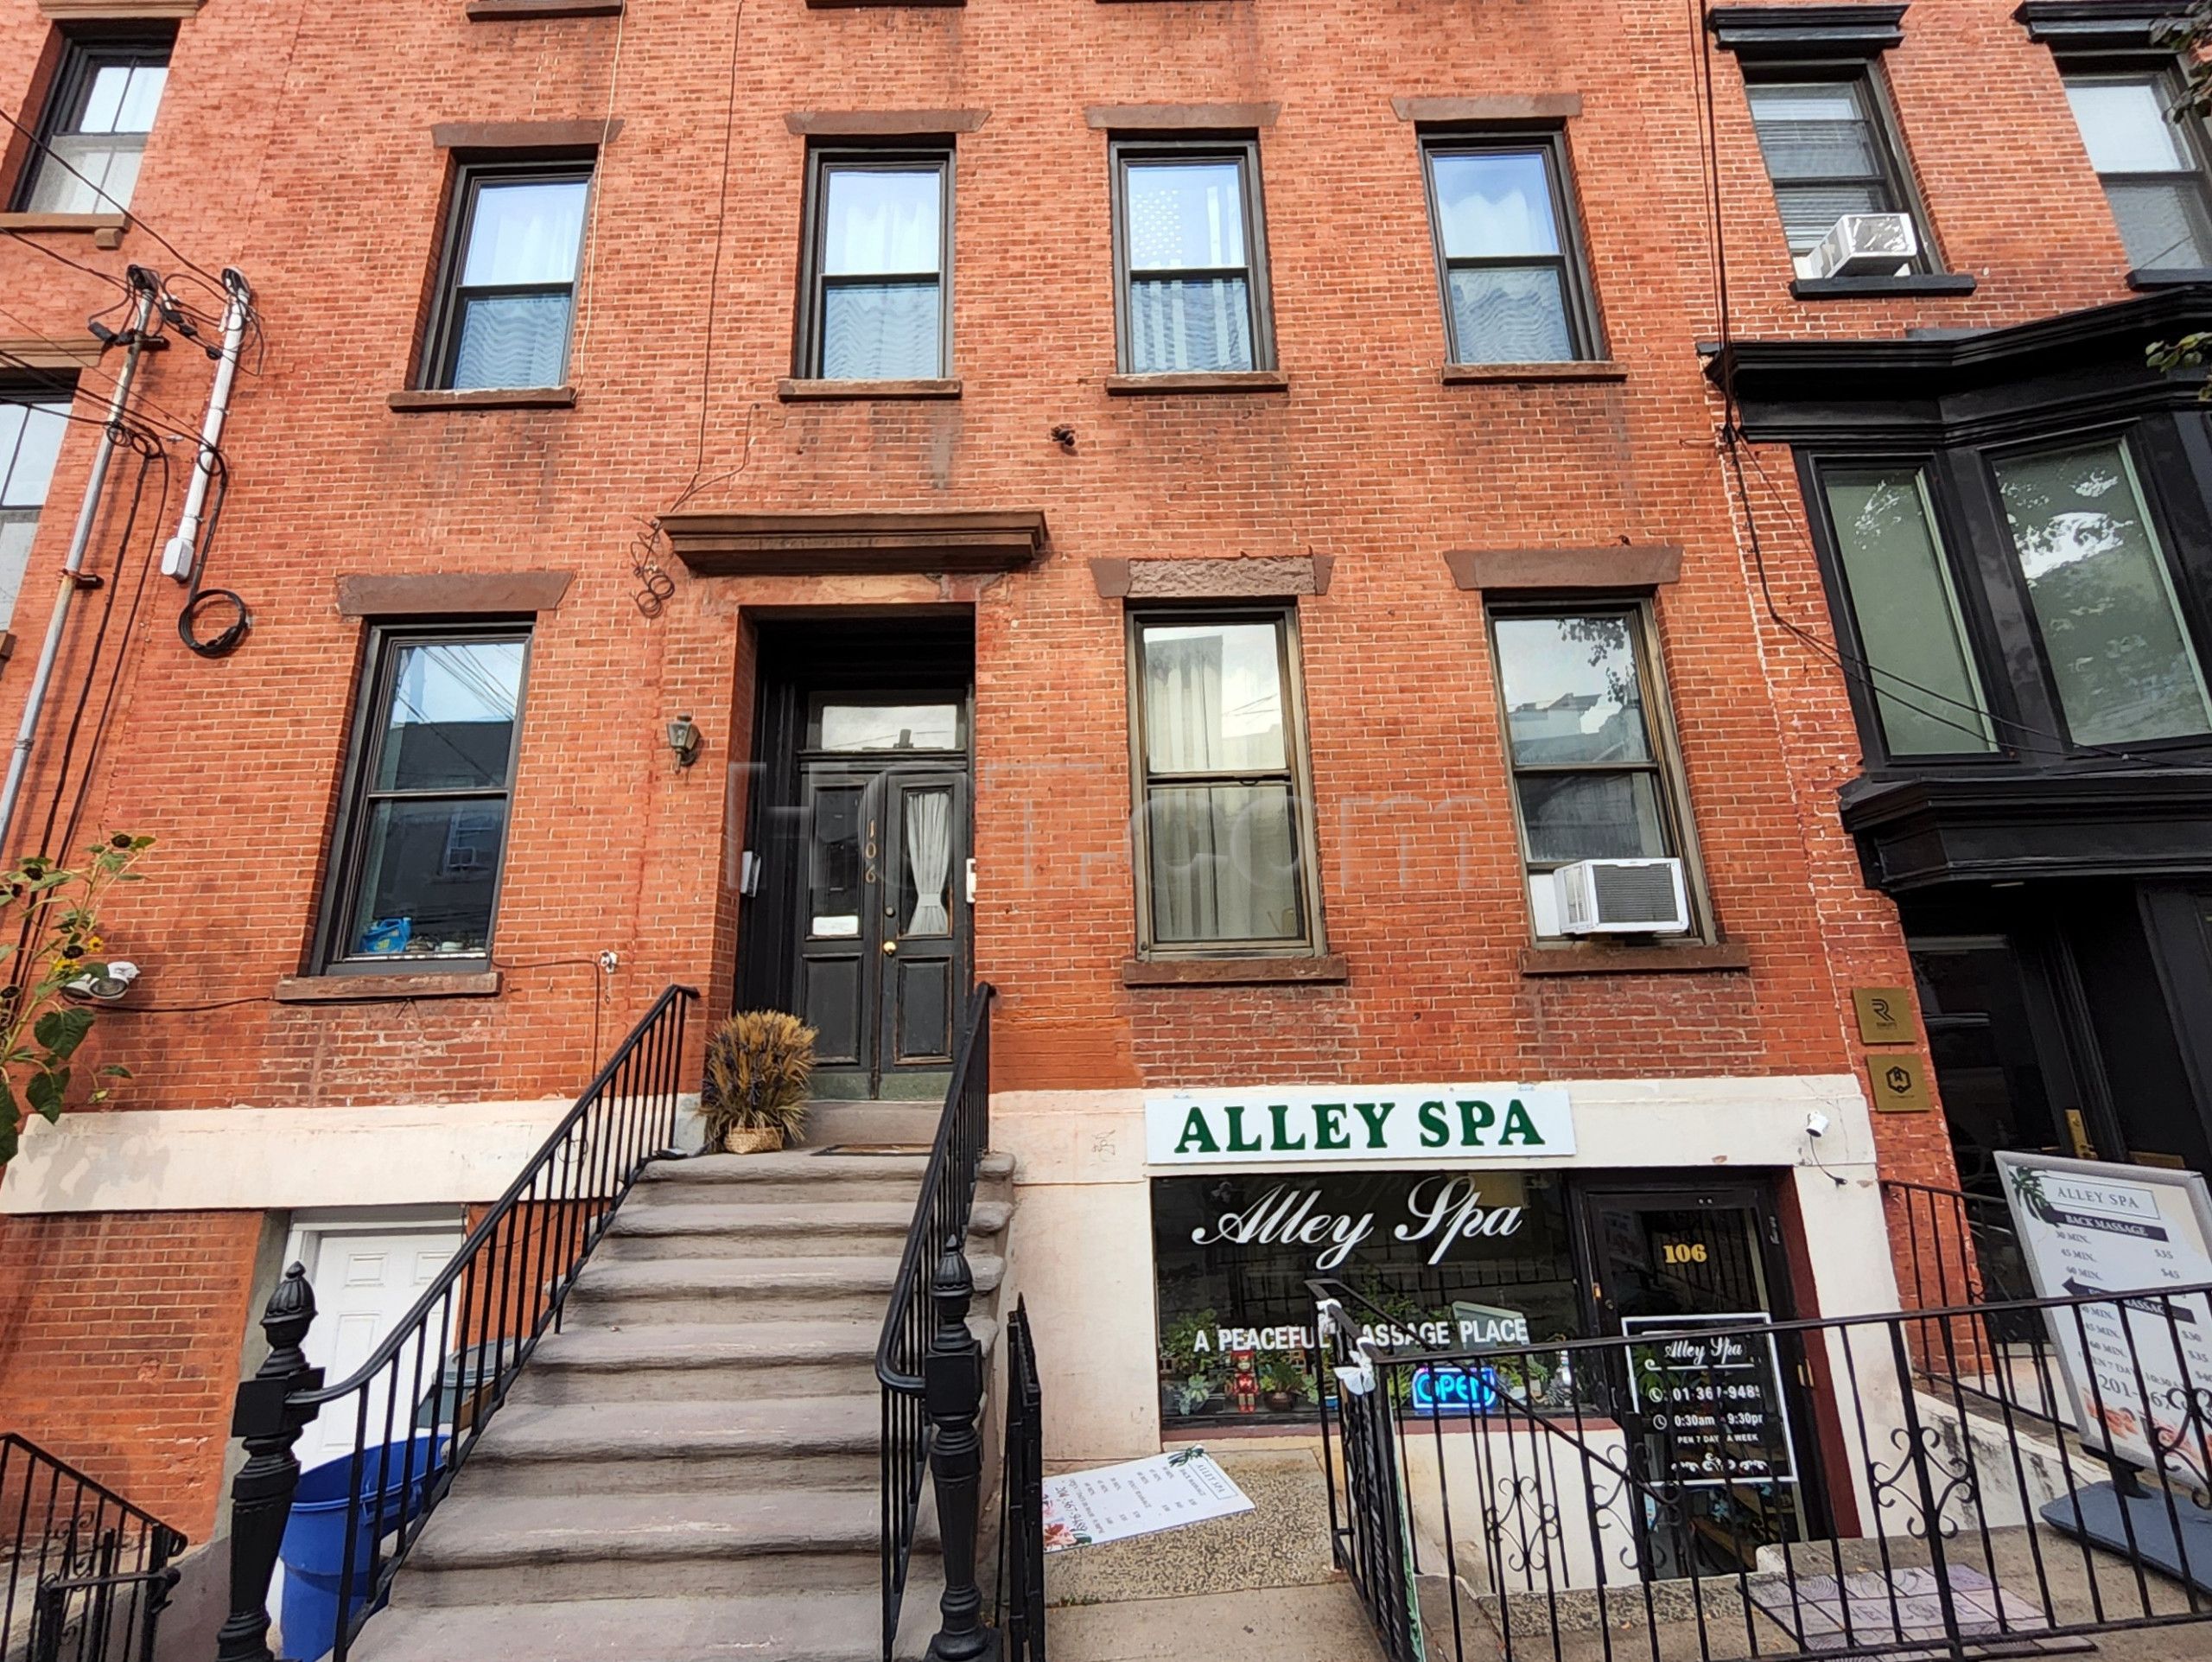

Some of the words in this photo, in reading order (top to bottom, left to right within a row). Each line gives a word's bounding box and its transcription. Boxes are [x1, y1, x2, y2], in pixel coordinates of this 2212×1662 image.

[865, 819, 877, 884] 106
[1173, 1101, 1395, 1153] ALLEY
[1417, 1098, 1546, 1148] SPA
[2057, 1187, 2104, 1204] ALLEY
[2108, 1194, 2139, 1209] SPA
[1191, 1181, 1376, 1270] Alley
[1394, 1175, 1524, 1265] Spa
[2064, 1215, 2094, 1228] BACK
[2094, 1219, 2149, 1237] MASSAGE
[1662, 1243, 1708, 1264] 106
[2122, 1299, 2166, 1315] ASSAG
[1193, 1329, 1211, 1353] A
[1217, 1324, 1332, 1352] PEACEFUL
[1361, 1321, 1451, 1347] ASSAGE
[1460, 1318, 1529, 1345] PLACE
[1664, 1340, 1706, 1366] Alley
[1710, 1337, 1743, 1365] Spa
[1417, 1373, 1490, 1402] OPEN
[1672, 1414, 1716, 1427] 0:30am
[1676, 1435, 1694, 1444] PEN
[1734, 1433, 1759, 1442] WEEK
